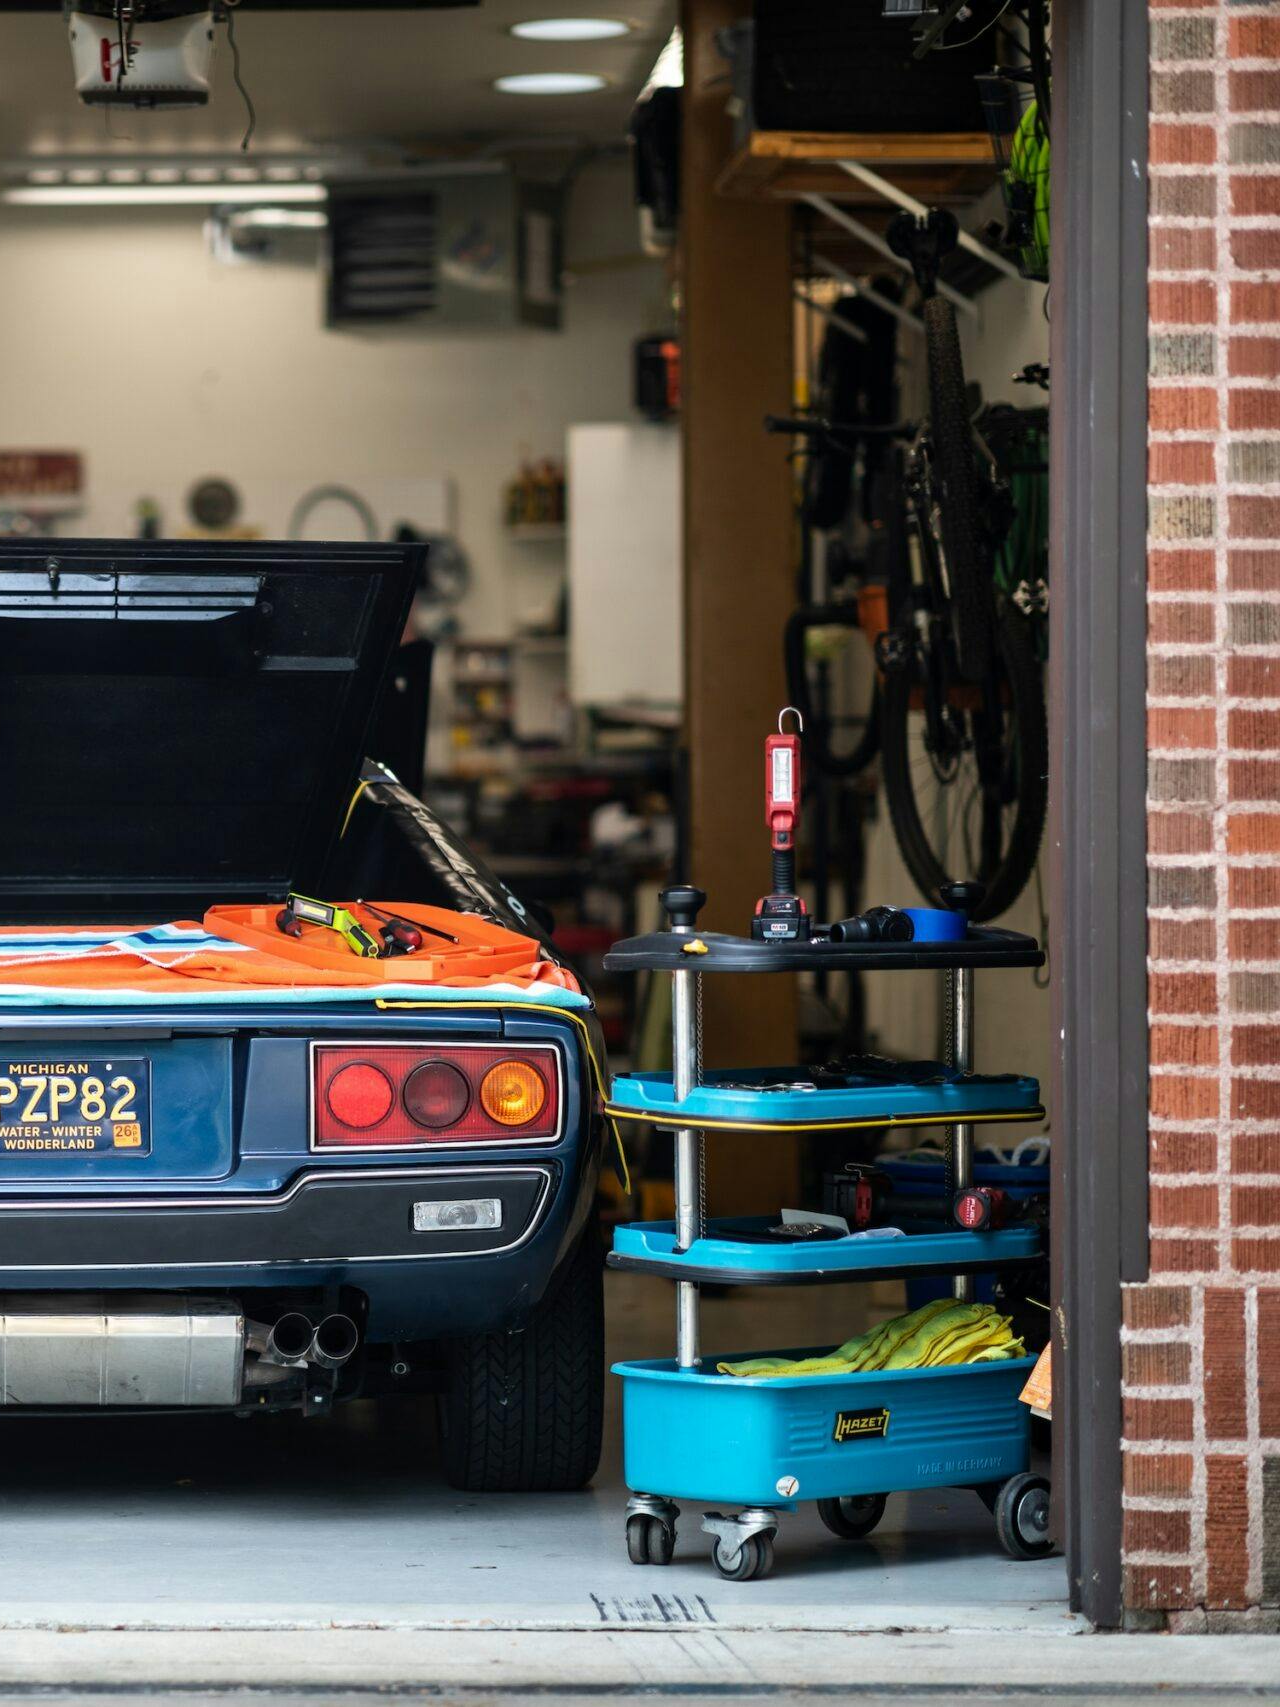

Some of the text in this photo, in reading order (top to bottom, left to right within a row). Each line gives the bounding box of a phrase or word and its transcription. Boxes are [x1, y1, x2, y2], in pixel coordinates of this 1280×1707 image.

[9, 1064, 89, 1075] MICHIGAN
[51, 1126, 102, 1137] WINTER
[115, 1125, 132, 1137] 26
[4, 1138, 95, 1150] WONDERLAND
[840, 1417, 885, 1435] HAZET
[917, 1456, 1002, 1475] MADE IN GERMANY
